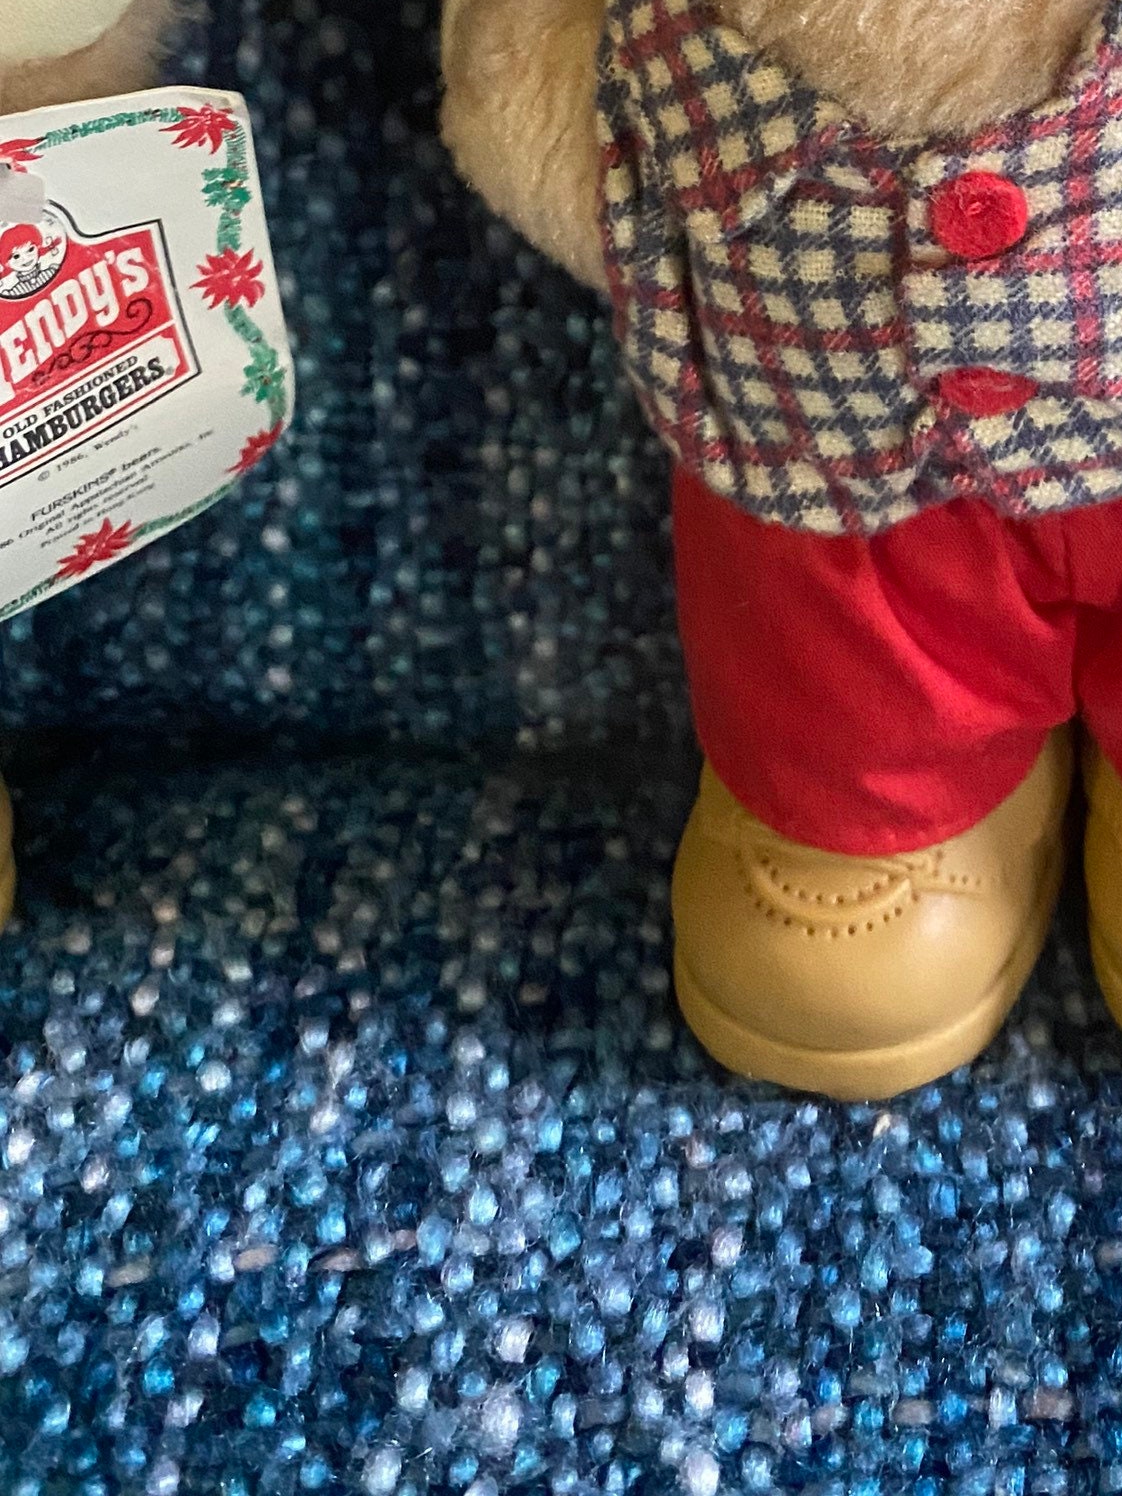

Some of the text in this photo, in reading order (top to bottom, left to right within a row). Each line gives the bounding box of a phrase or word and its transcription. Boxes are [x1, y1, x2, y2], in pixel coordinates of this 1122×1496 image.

[0, 246, 150, 401] ENDY'S
[3, 355, 139, 440] OLD FASHIONED
